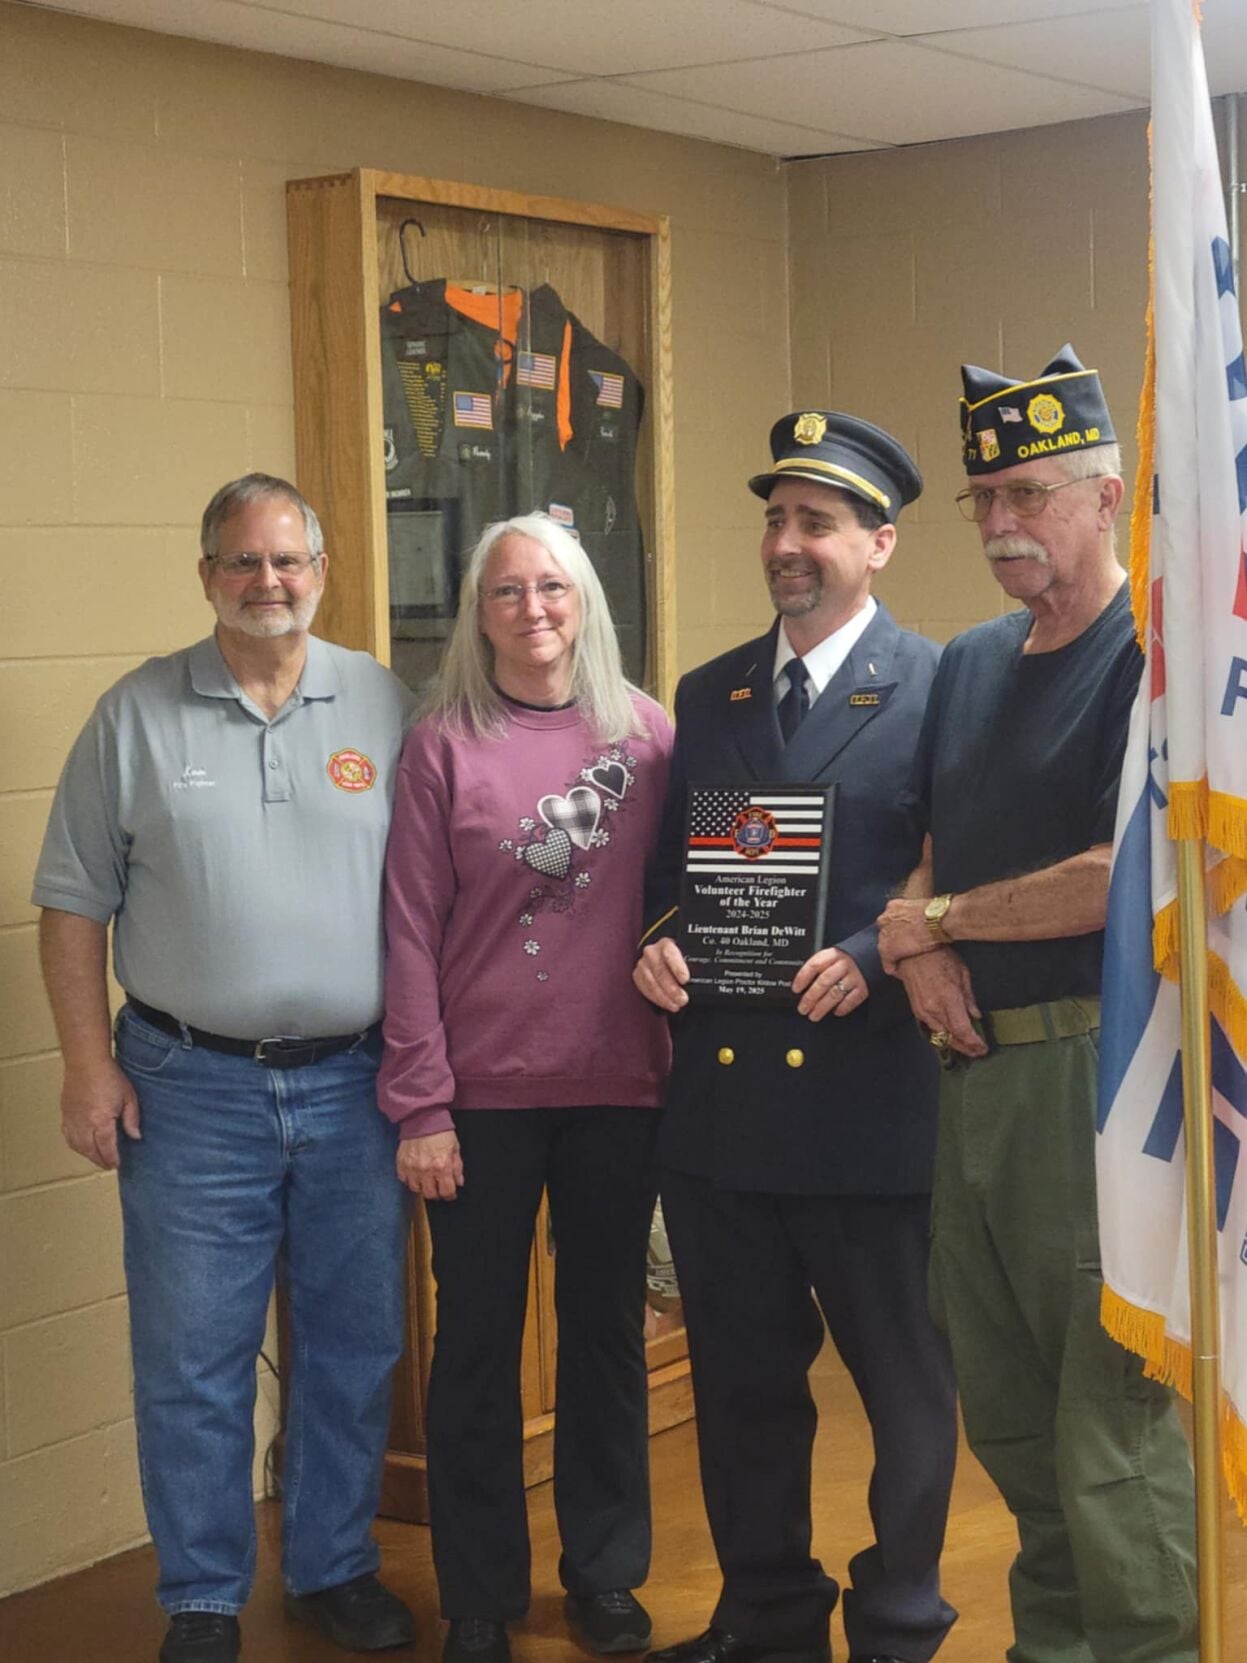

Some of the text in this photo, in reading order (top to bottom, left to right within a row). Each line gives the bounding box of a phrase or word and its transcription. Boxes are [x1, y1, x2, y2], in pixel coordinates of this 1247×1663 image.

[1017, 431, 1085, 459] OAKLAND,
[715, 874, 787, 886] American Legion
[694, 884, 807, 899] Volunteer Firefighter
[719, 896, 779, 908] of the Year
[725, 909, 771, 920] 2024-2025
[687, 923, 806, 937] Lieutenant Brian DeWitt
[772, 938, 790, 948] MD
[755, 957, 767, 965] and
[718, 985, 733, 995] May
[748, 986, 766, 996] 2025
